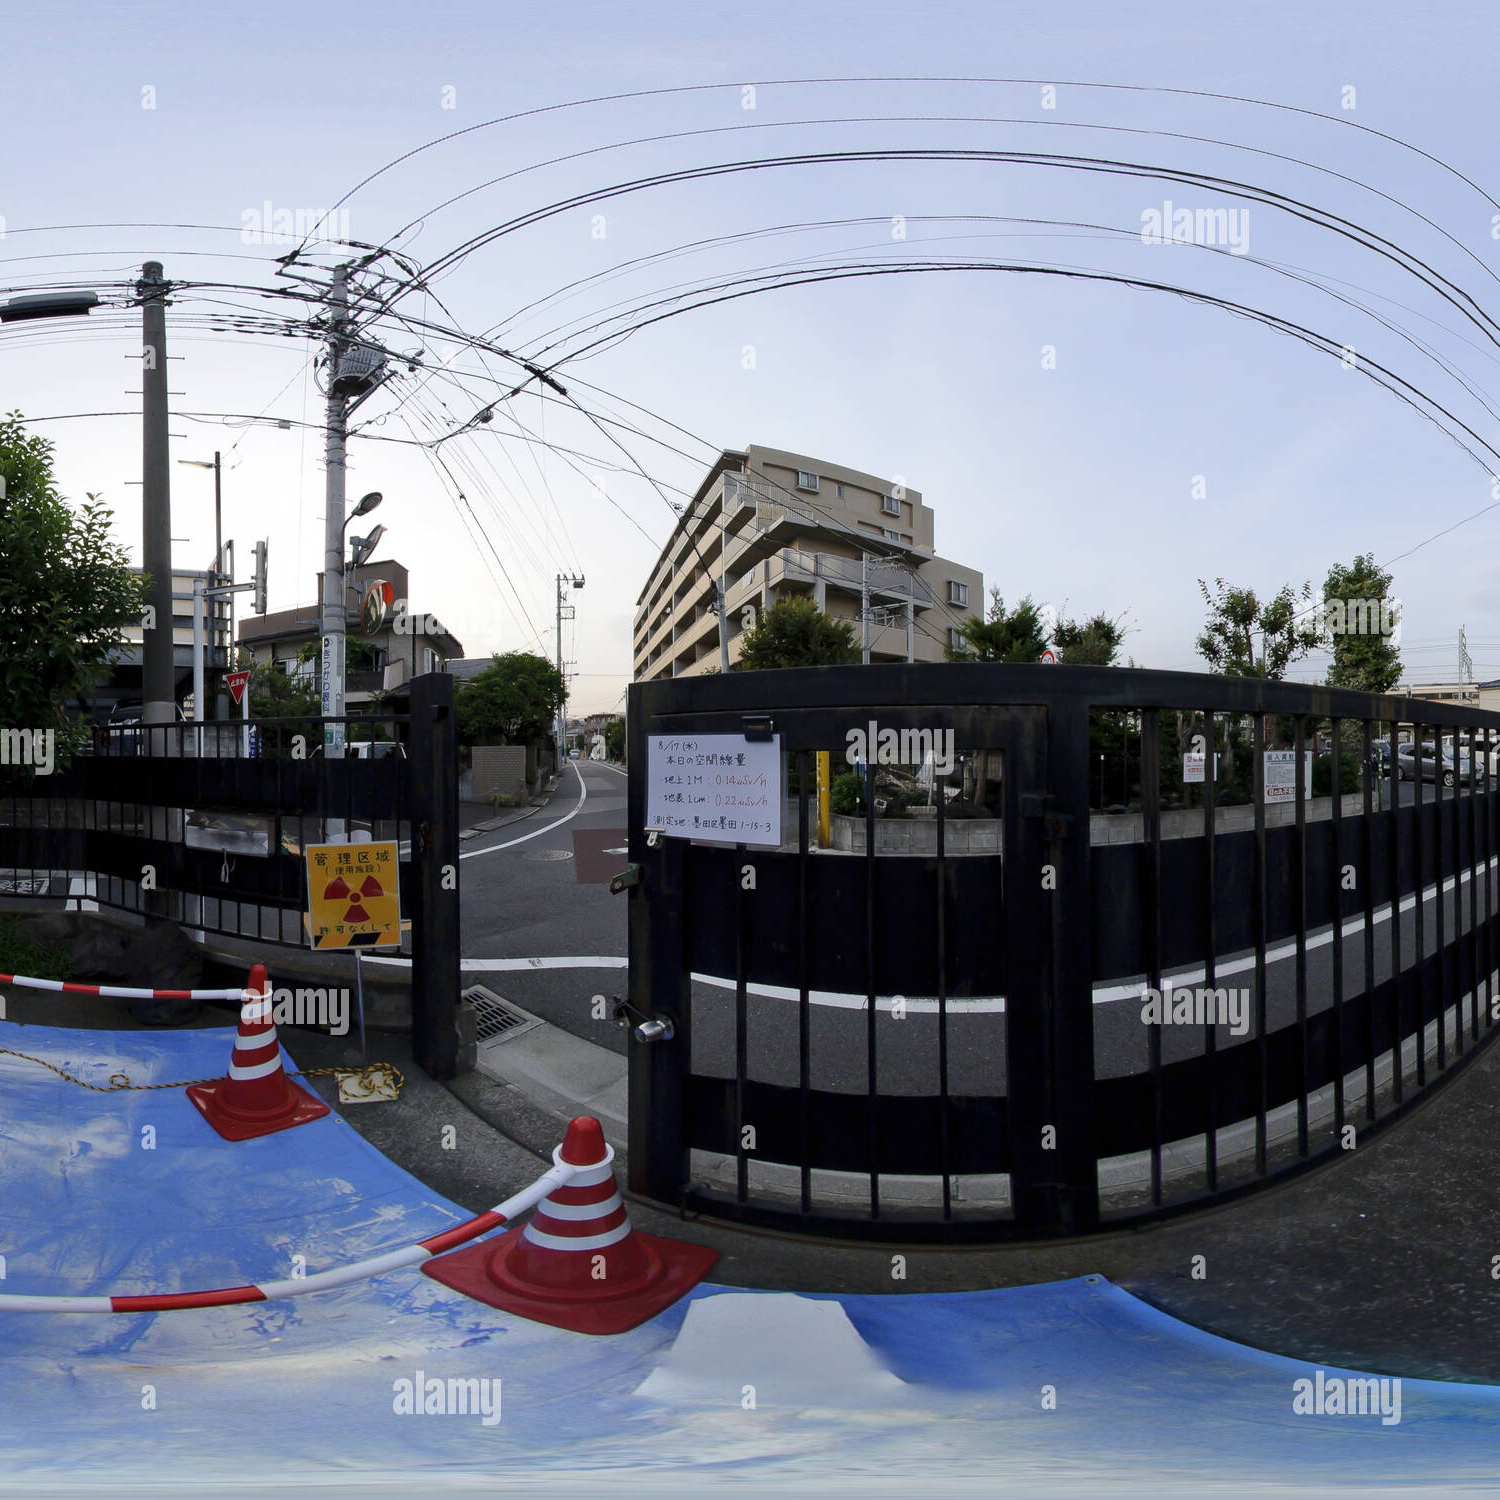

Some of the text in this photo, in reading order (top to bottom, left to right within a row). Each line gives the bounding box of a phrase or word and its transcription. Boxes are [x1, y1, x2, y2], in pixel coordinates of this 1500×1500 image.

[230, 678, 245, 687] 止まれ
[666, 753, 746, 767] 本日の空間線量
[314, 850, 390, 866] 管理区域
[319, 923, 392, 934] 許可なくして
